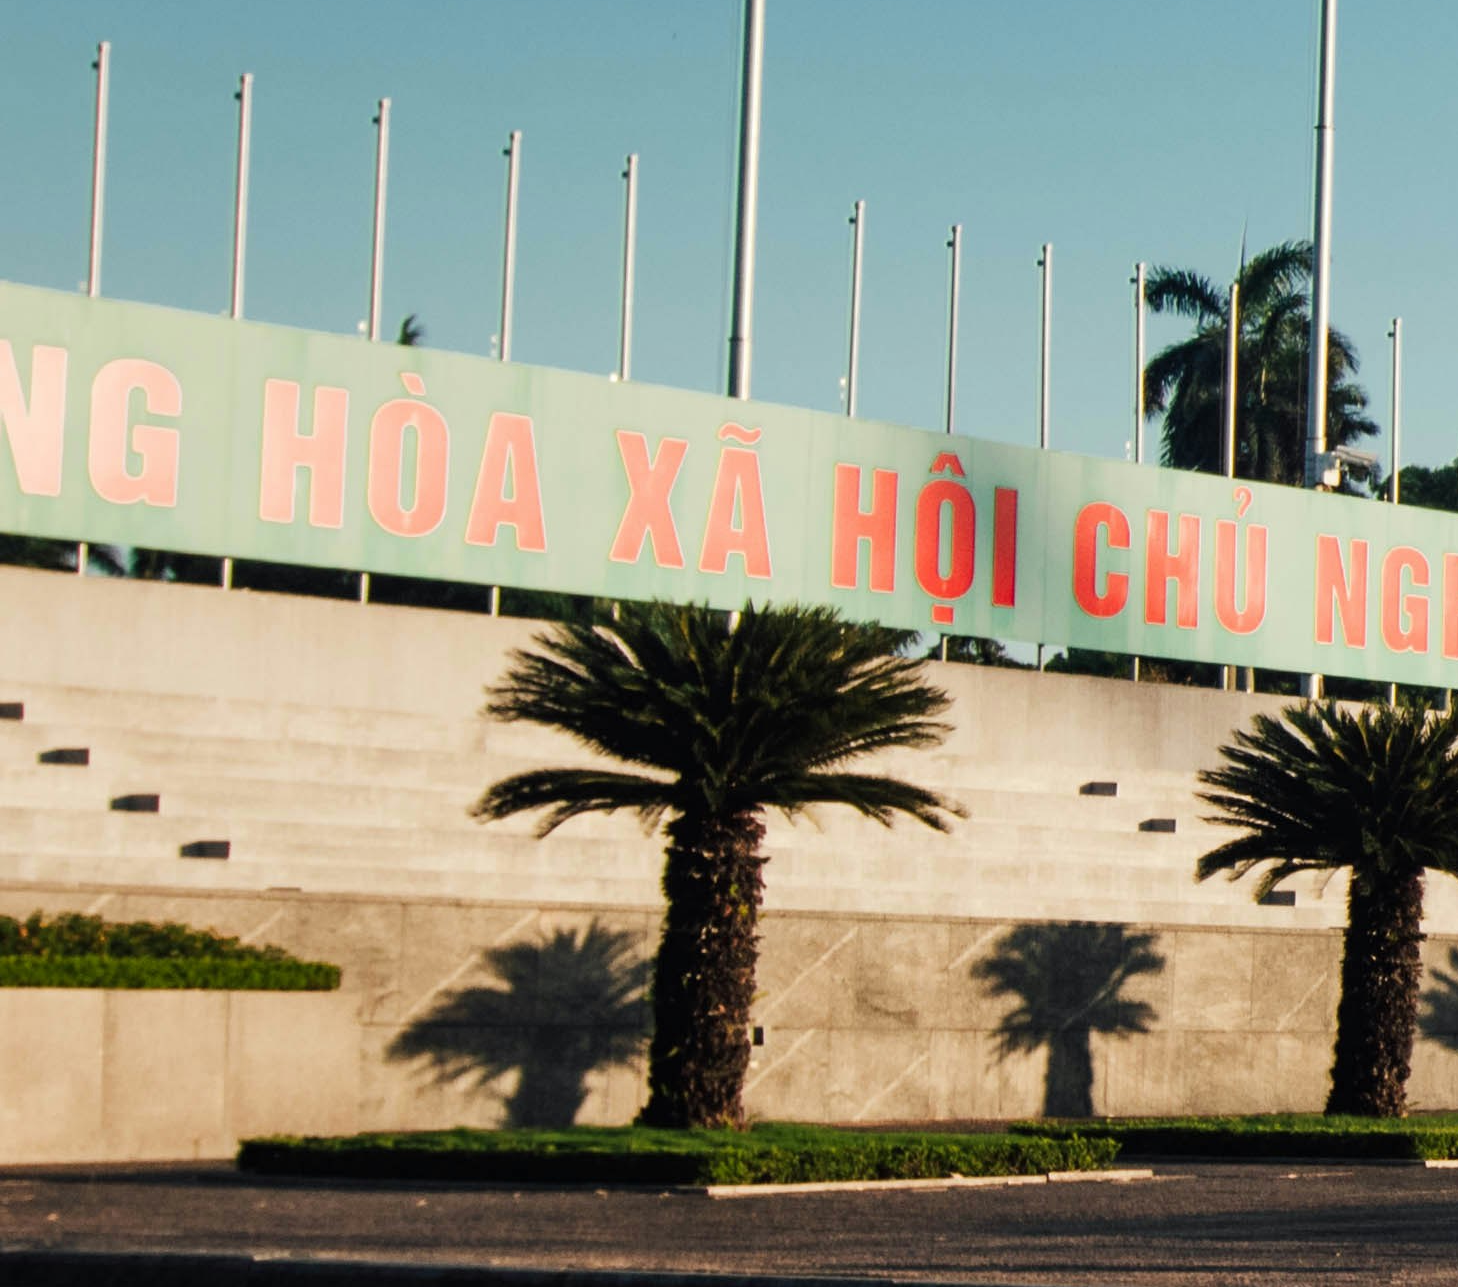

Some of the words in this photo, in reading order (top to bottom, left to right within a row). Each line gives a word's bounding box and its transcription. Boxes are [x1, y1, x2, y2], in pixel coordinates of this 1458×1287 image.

[259, 373, 548, 553] HÒA
[610, 422, 773, 580] XÃ
[830, 450, 1019, 625] HỘI
[1072, 485, 1270, 635] CHỦ
